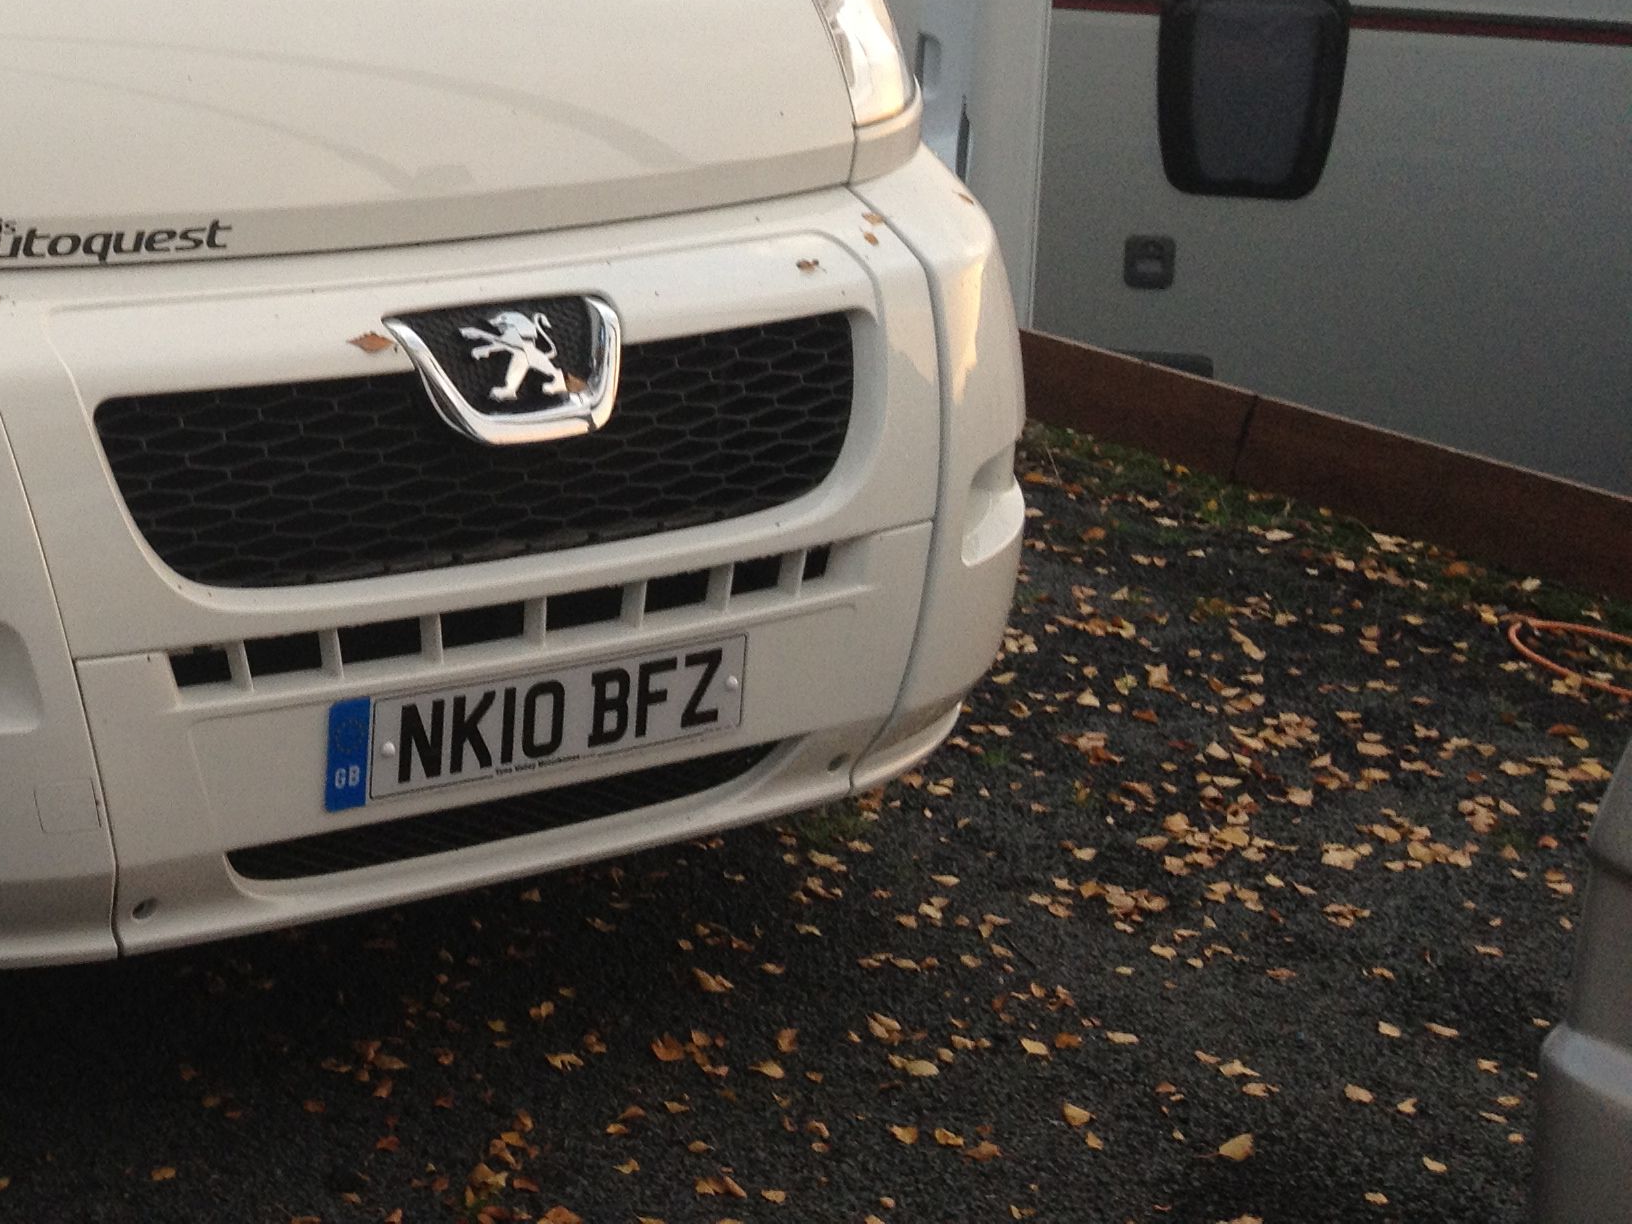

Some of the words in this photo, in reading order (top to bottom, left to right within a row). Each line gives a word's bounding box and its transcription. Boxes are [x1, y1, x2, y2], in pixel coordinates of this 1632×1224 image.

[398, 680, 566, 784] NK10
[588, 648, 722, 748] BFZ
[335, 765, 360, 789] GB
